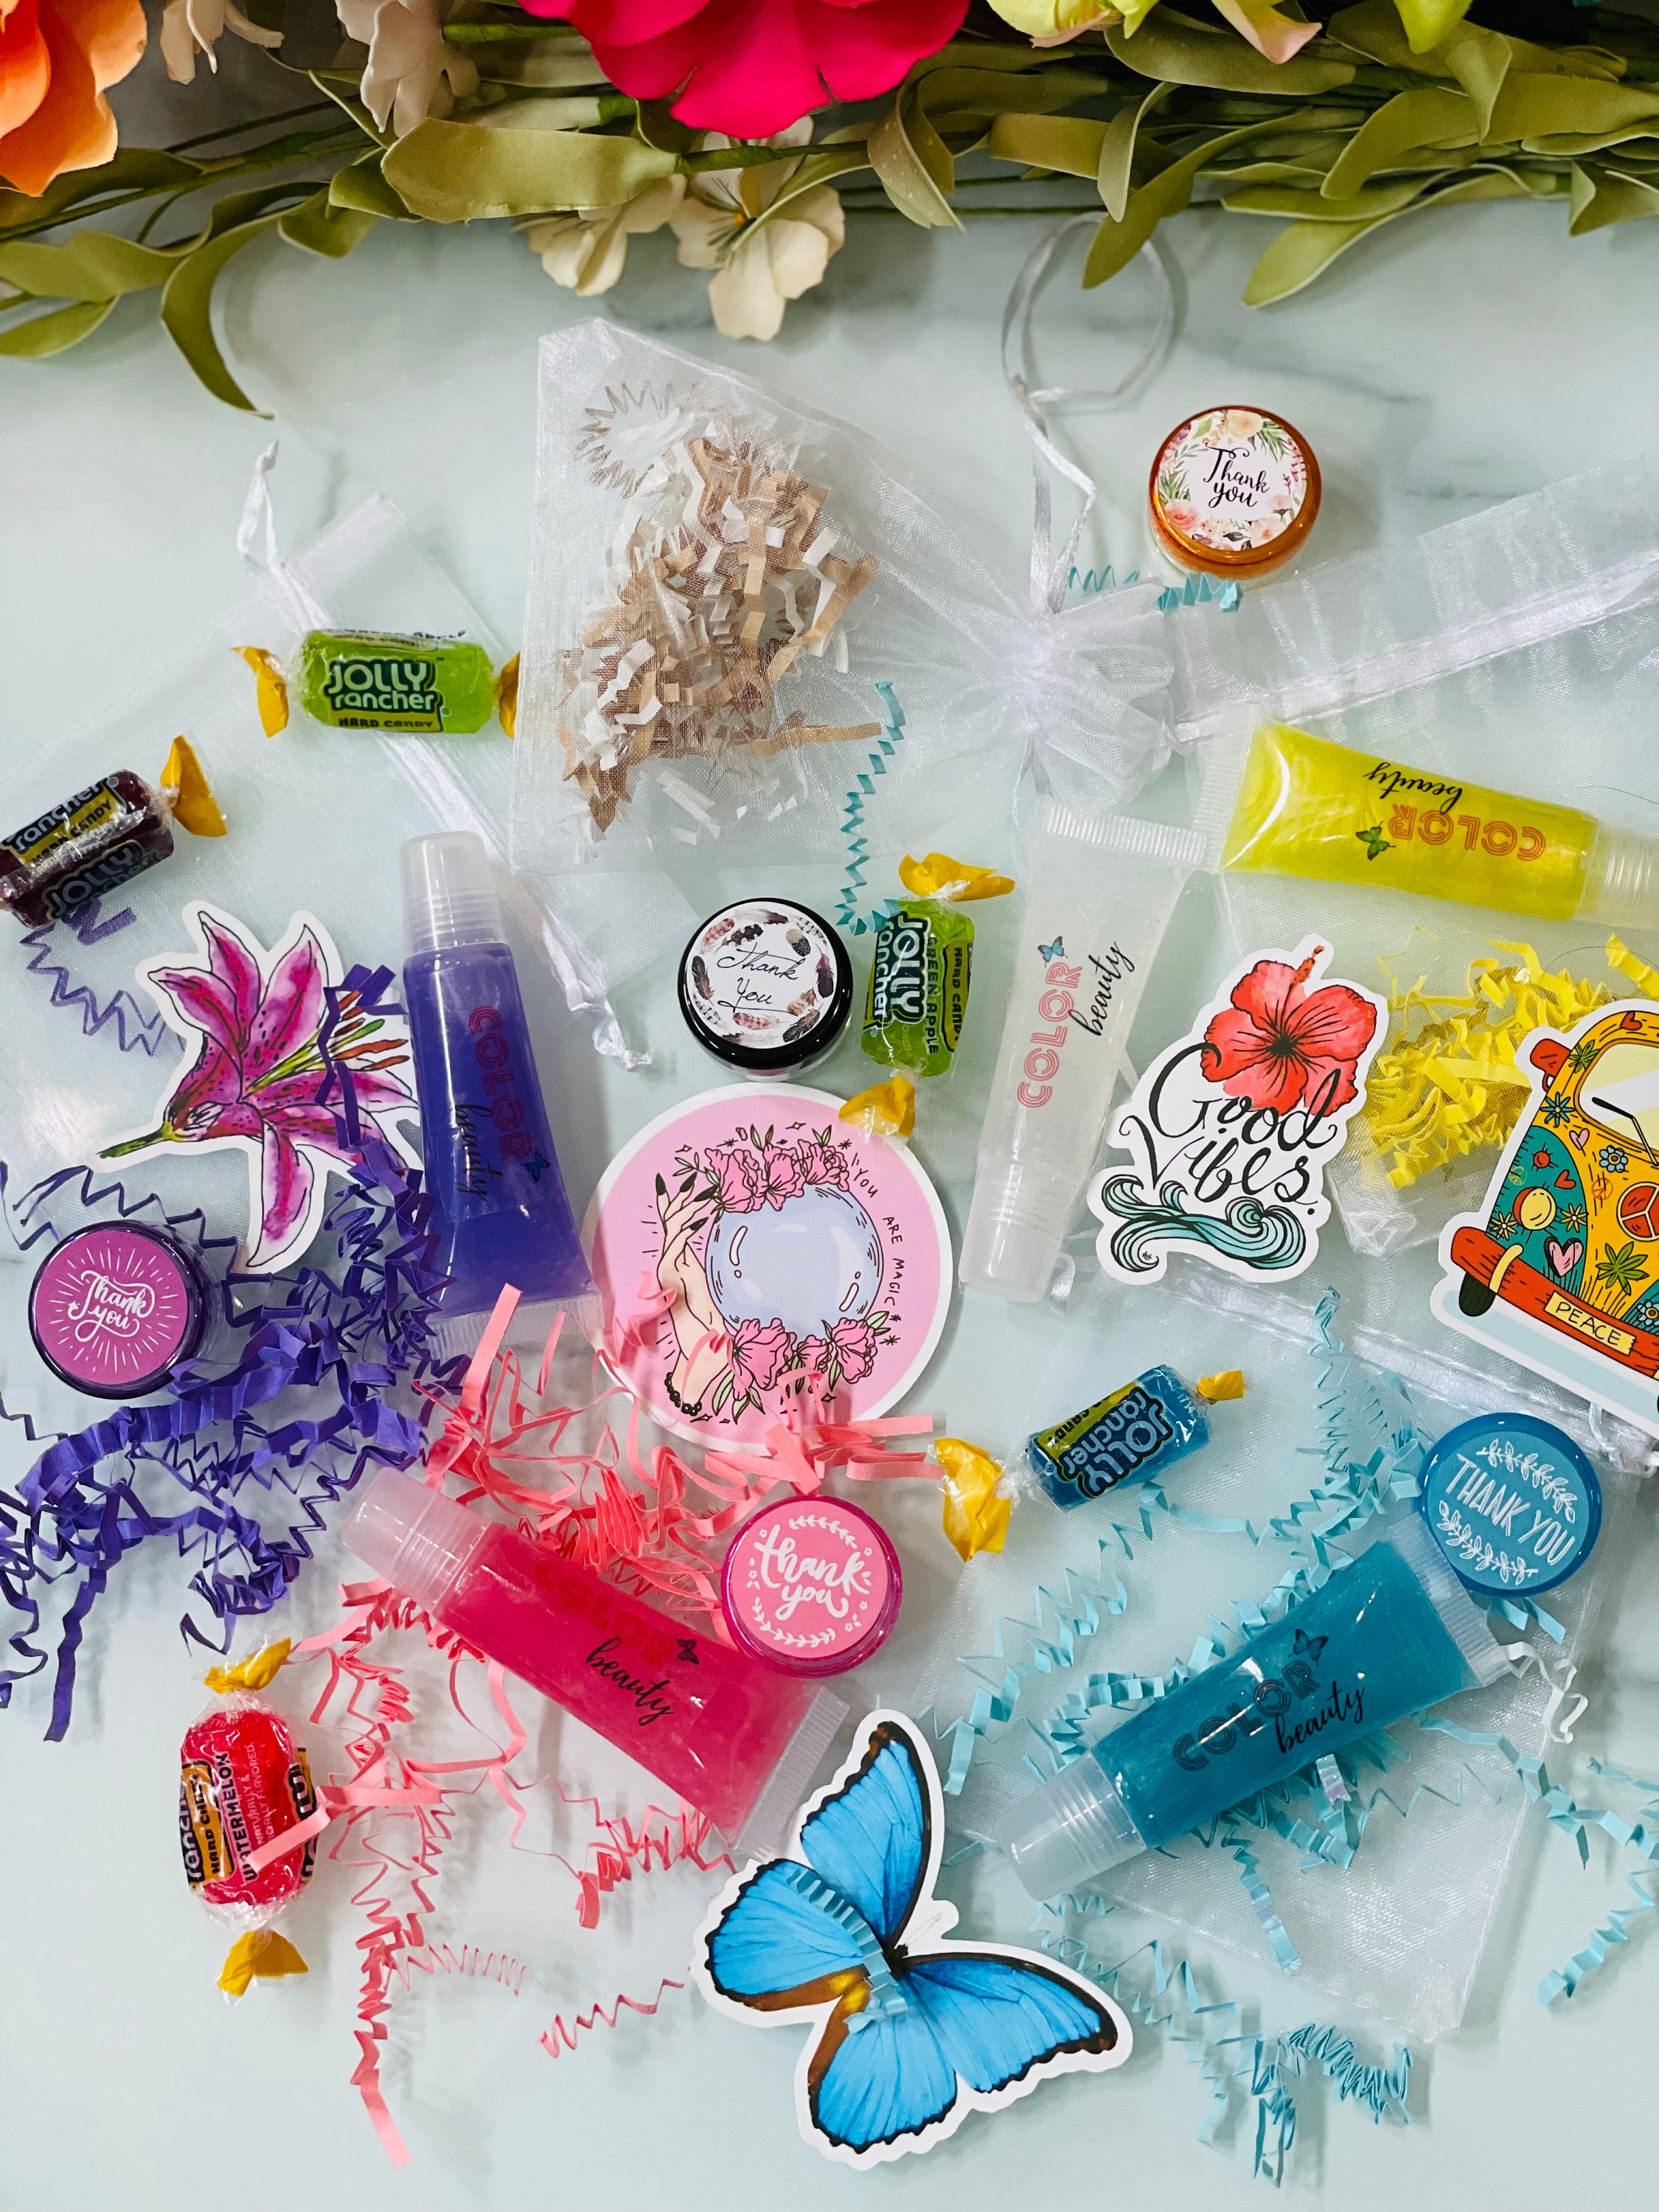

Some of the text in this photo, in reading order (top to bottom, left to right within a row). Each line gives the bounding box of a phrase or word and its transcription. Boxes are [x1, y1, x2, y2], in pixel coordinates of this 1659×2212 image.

[1203, 442, 1270, 493] Thank
[1208, 482, 1257, 508] you
[329, 663, 428, 694] JOLLY
[335, 690, 434, 710] rancher
[338, 717, 434, 728] HARD CANDY
[15, 785, 100, 850] rancher
[70, 799, 113, 838] CANDY
[1363, 762, 1463, 815] beauty
[1388, 804, 1546, 861] COLOR
[51, 847, 134, 917] JOLLY
[717, 942, 806, 980] Thank
[717, 977, 799, 1017] You
[874, 921, 894, 1019] rancher
[890, 915, 923, 1014] JOLLY
[925, 936, 939, 1054] GREEN APPLE
[952, 947, 963, 1041] HARD CAND
[1068, 940, 1135, 1036] beauty
[1018, 962, 1082, 1107] COLOR
[468, 1005, 532, 1162] COLOR
[1149, 1042, 1341, 1152] Good
[455, 1105, 504, 1202] beauty
[854, 1167, 905, 1307] YOU ARE MAGIC
[67, 1270, 156, 1320] Thank
[75, 1304, 140, 1342] you
[1555, 1301, 1621, 1346] PEACE
[1063, 1391, 1147, 1475] rancher
[1084, 1403, 1169, 1492] JOLLY
[1445, 1453, 1576, 1566] THANK YOU
[754, 1524, 870, 1596] thank
[775, 1584, 849, 1621] you
[585, 1636, 675, 1727] beauty
[1172, 1660, 1323, 1771] COLOR
[1275, 1680, 1366, 1754] beauty
[179, 1777, 202, 1878] ranch
[205, 1829, 220, 1874] HARD
